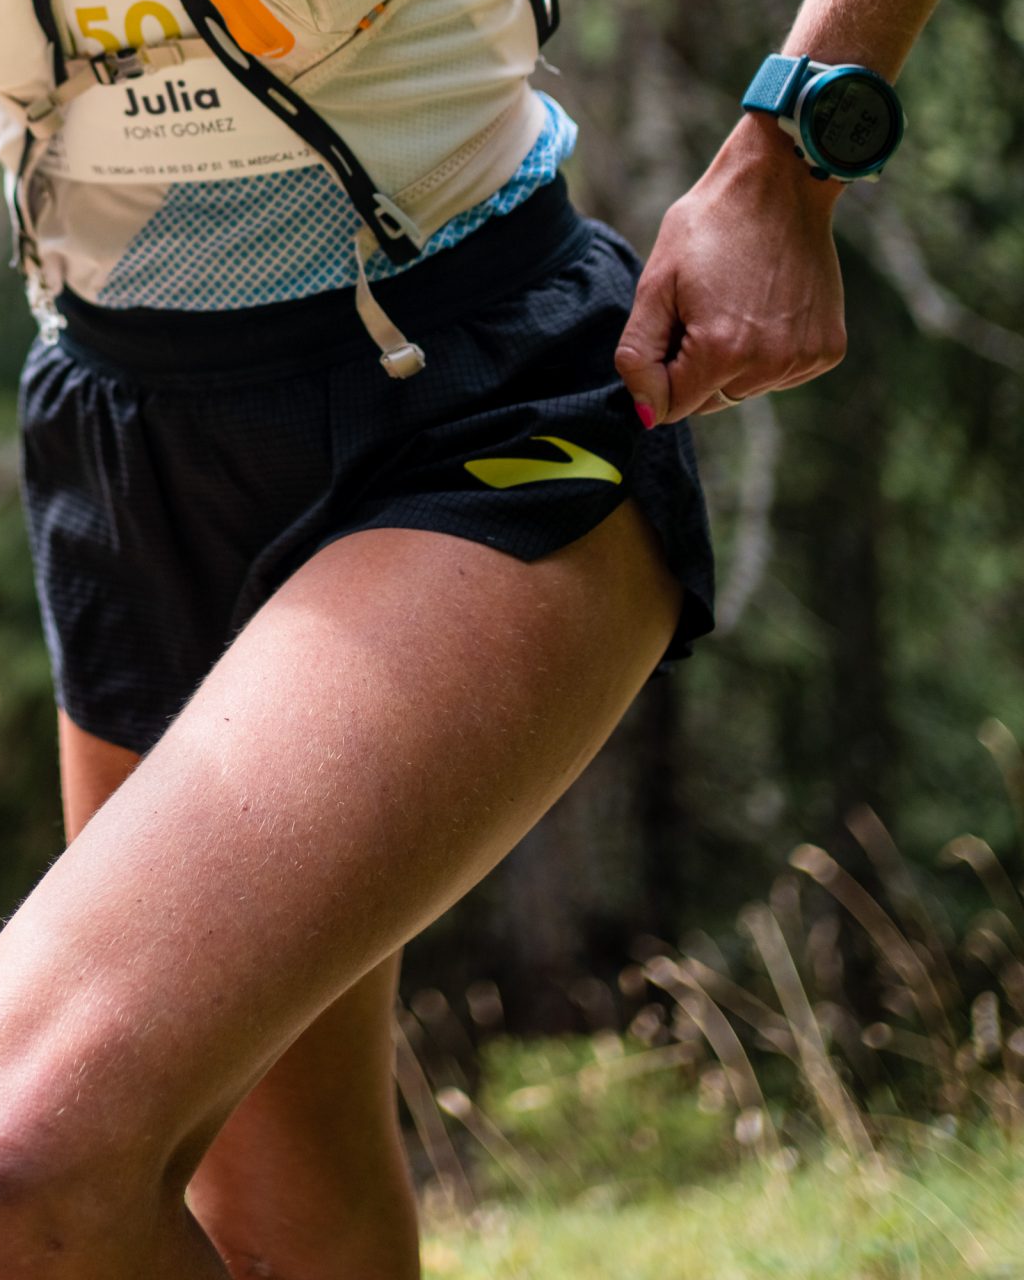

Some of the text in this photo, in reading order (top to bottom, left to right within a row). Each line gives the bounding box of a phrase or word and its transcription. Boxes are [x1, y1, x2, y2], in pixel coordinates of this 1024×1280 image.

[124, 80, 221, 116] Julia
[124, 118, 236, 140] FONT GOMEZ
[248, 151, 294, 166] MEDICAL
